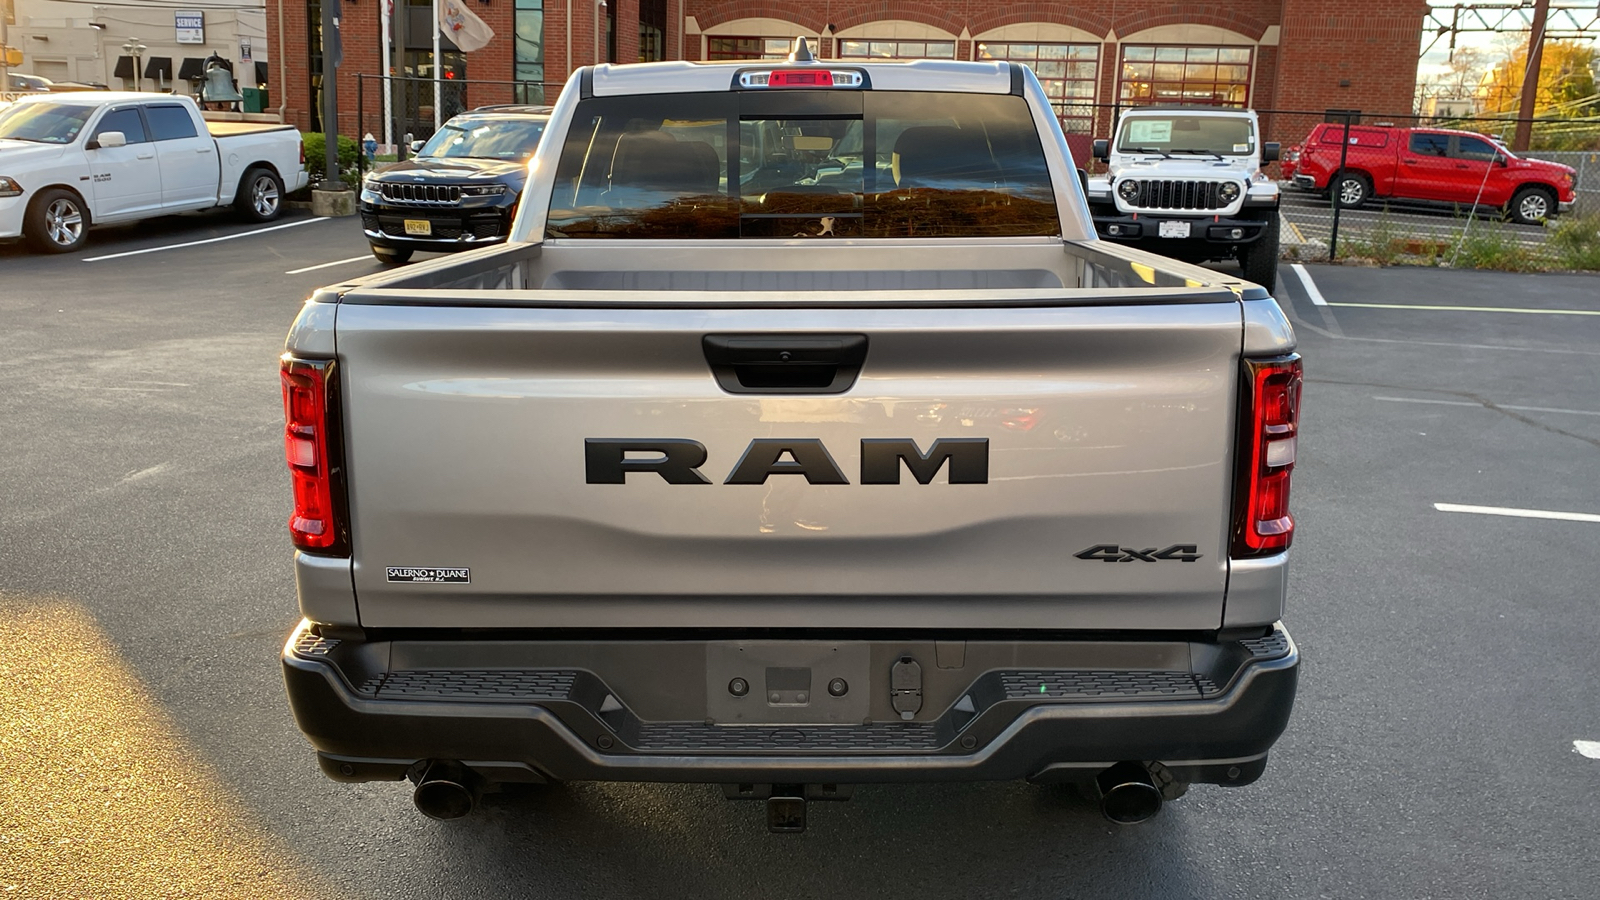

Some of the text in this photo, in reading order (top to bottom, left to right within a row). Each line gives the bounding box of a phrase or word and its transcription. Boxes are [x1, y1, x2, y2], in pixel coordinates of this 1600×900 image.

[176, 18, 202, 28] SERVICE
[585, 438, 990, 485] RAM
[1072, 544, 1204, 562] 4x4
[388, 569, 467, 578] SALERNO DUANE
